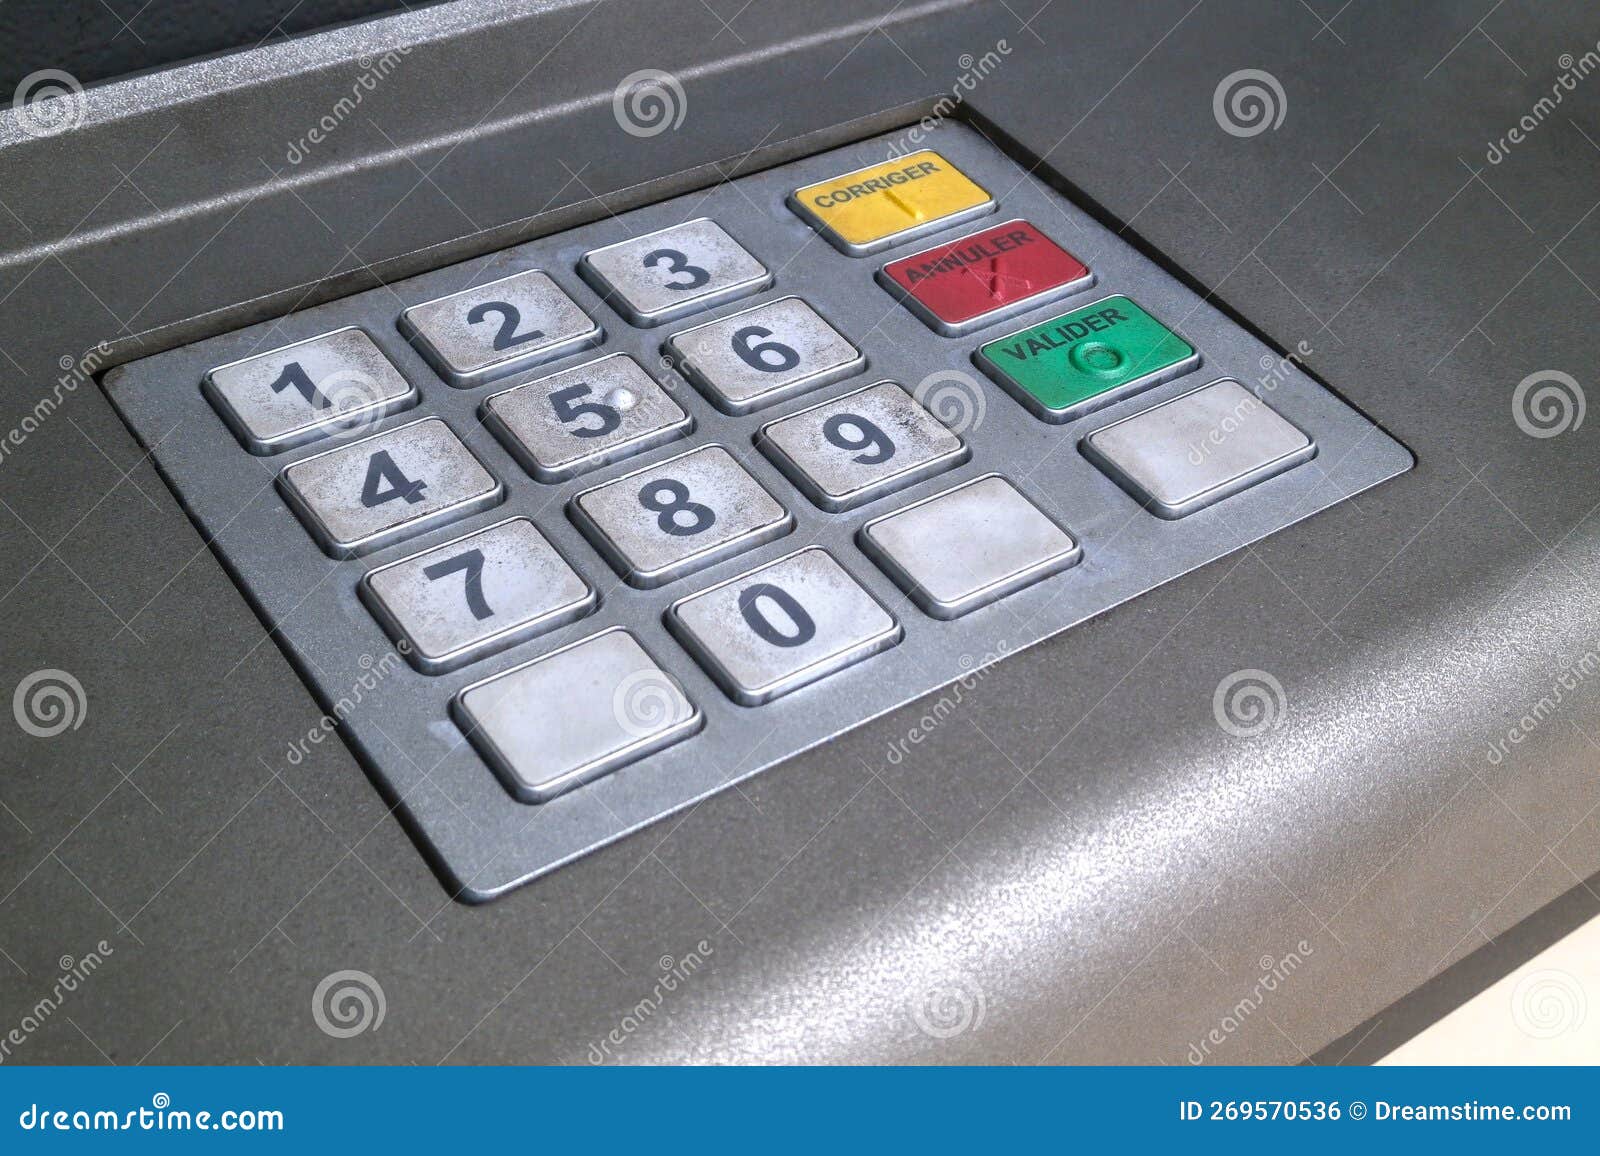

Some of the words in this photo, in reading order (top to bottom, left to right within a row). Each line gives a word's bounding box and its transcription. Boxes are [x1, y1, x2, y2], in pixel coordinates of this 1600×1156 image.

[815, 161, 941, 208] CORRIGER
[644, 249, 710, 290] 3
[905, 230, 1033, 284] ANNULER
[467, 302, 545, 351] 2
[732, 326, 800, 372] 6
[1001, 307, 1129, 362] VALIDER
[270, 361, 332, 410] 1
[548, 382, 621, 438] 5
[823, 414, 895, 464] 9
[361, 450, 427, 508] 4
[638, 479, 715, 536] 8
[424, 549, 494, 620] 7
[739, 584, 815, 647] 0
